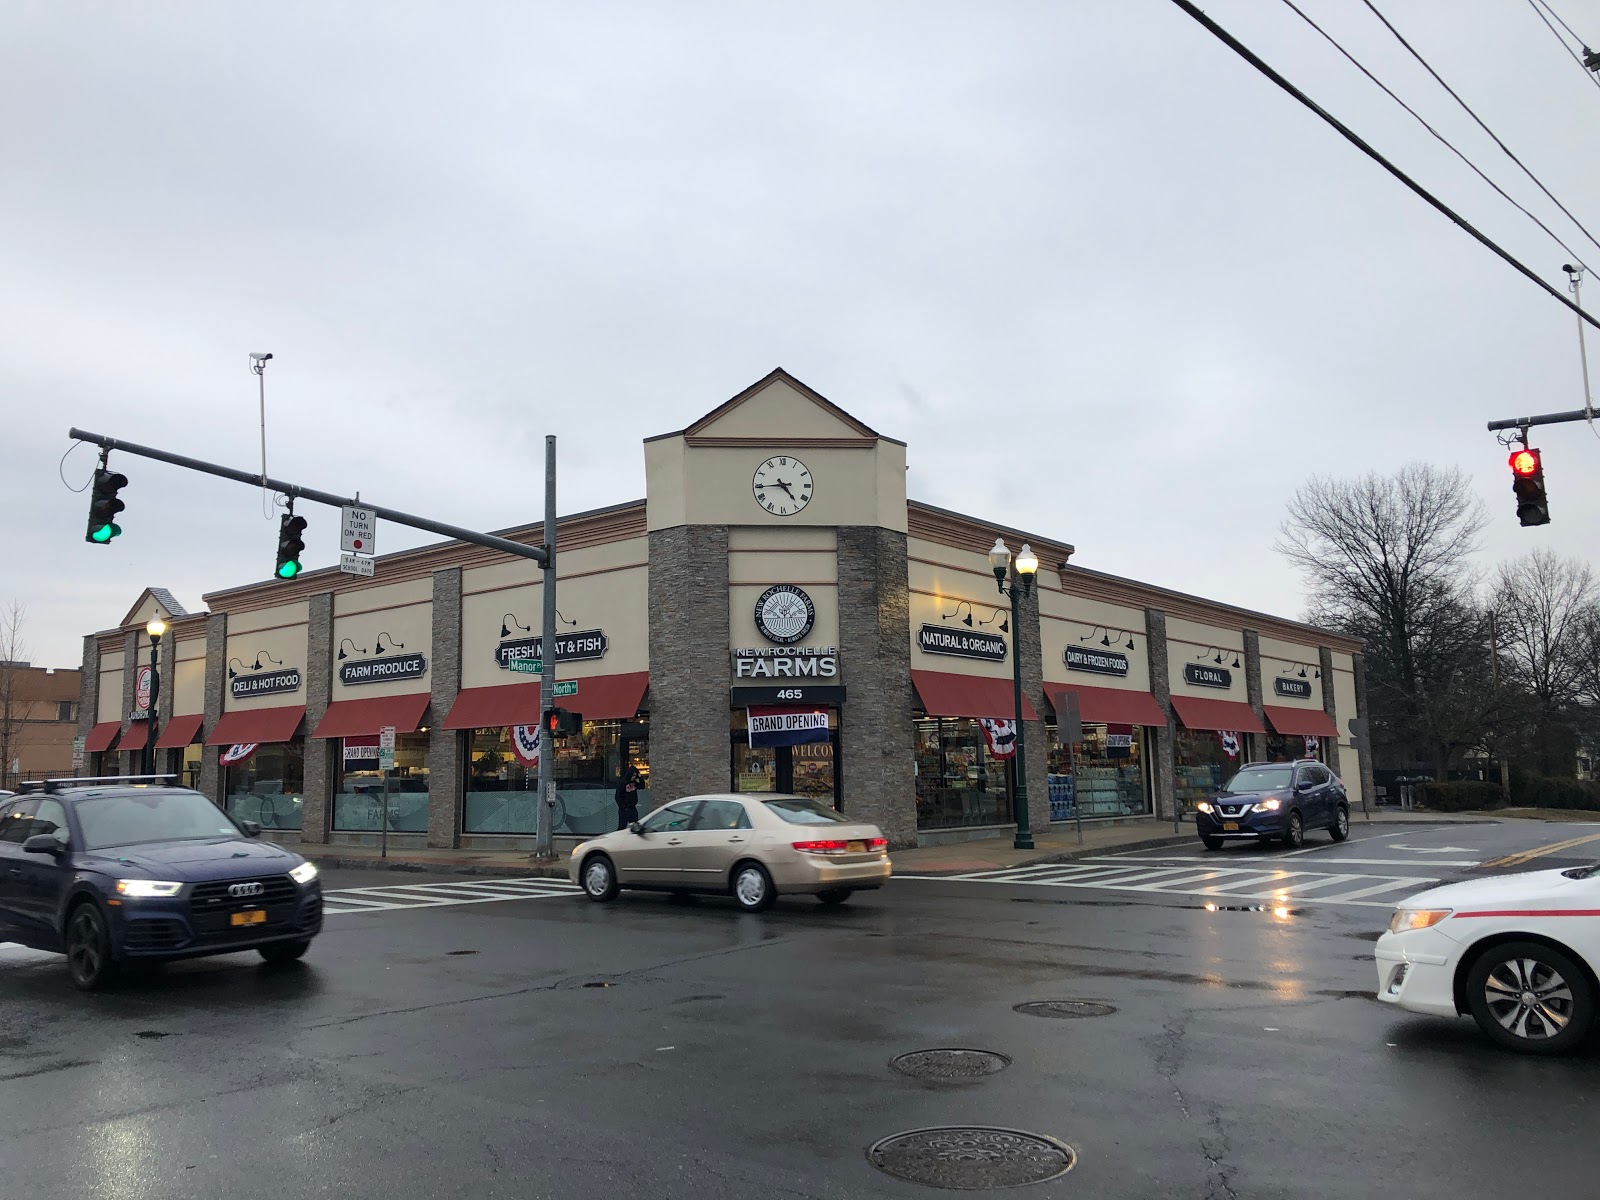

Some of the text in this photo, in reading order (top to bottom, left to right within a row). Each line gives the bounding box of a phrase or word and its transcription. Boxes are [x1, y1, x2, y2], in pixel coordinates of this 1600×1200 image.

[352, 511, 366, 520] NO
[350, 521, 368, 530] TURN
[762, 586, 800, 600] ROCHELLE
[800, 593, 814, 616] FARMS
[502, 638, 601, 660] FRESH MAT & FISH
[922, 631, 1004, 654] NATURAL & ORGANIC
[736, 646, 836, 656] NEW ROCHELLE
[511, 660, 536, 671] Manor
[1067, 652, 1083, 664] DAIRY
[1088, 655, 1109, 667] FROZEN
[1110, 658, 1126, 670] FOODS
[345, 660, 419, 679] FARM PRODUCE
[736, 658, 837, 678] FARMS
[1194, 669, 1222, 682] FLORAL
[233, 675, 298, 692] DELI & HOT FOOD
[554, 683, 572, 694] North
[1282, 682, 1304, 693] BAKERY
[777, 689, 803, 699] 465
[752, 714, 825, 731] GRAND OPENING
[345, 747, 380, 758] GRAND OPENING
[791, 744, 833, 757] WELCOM
